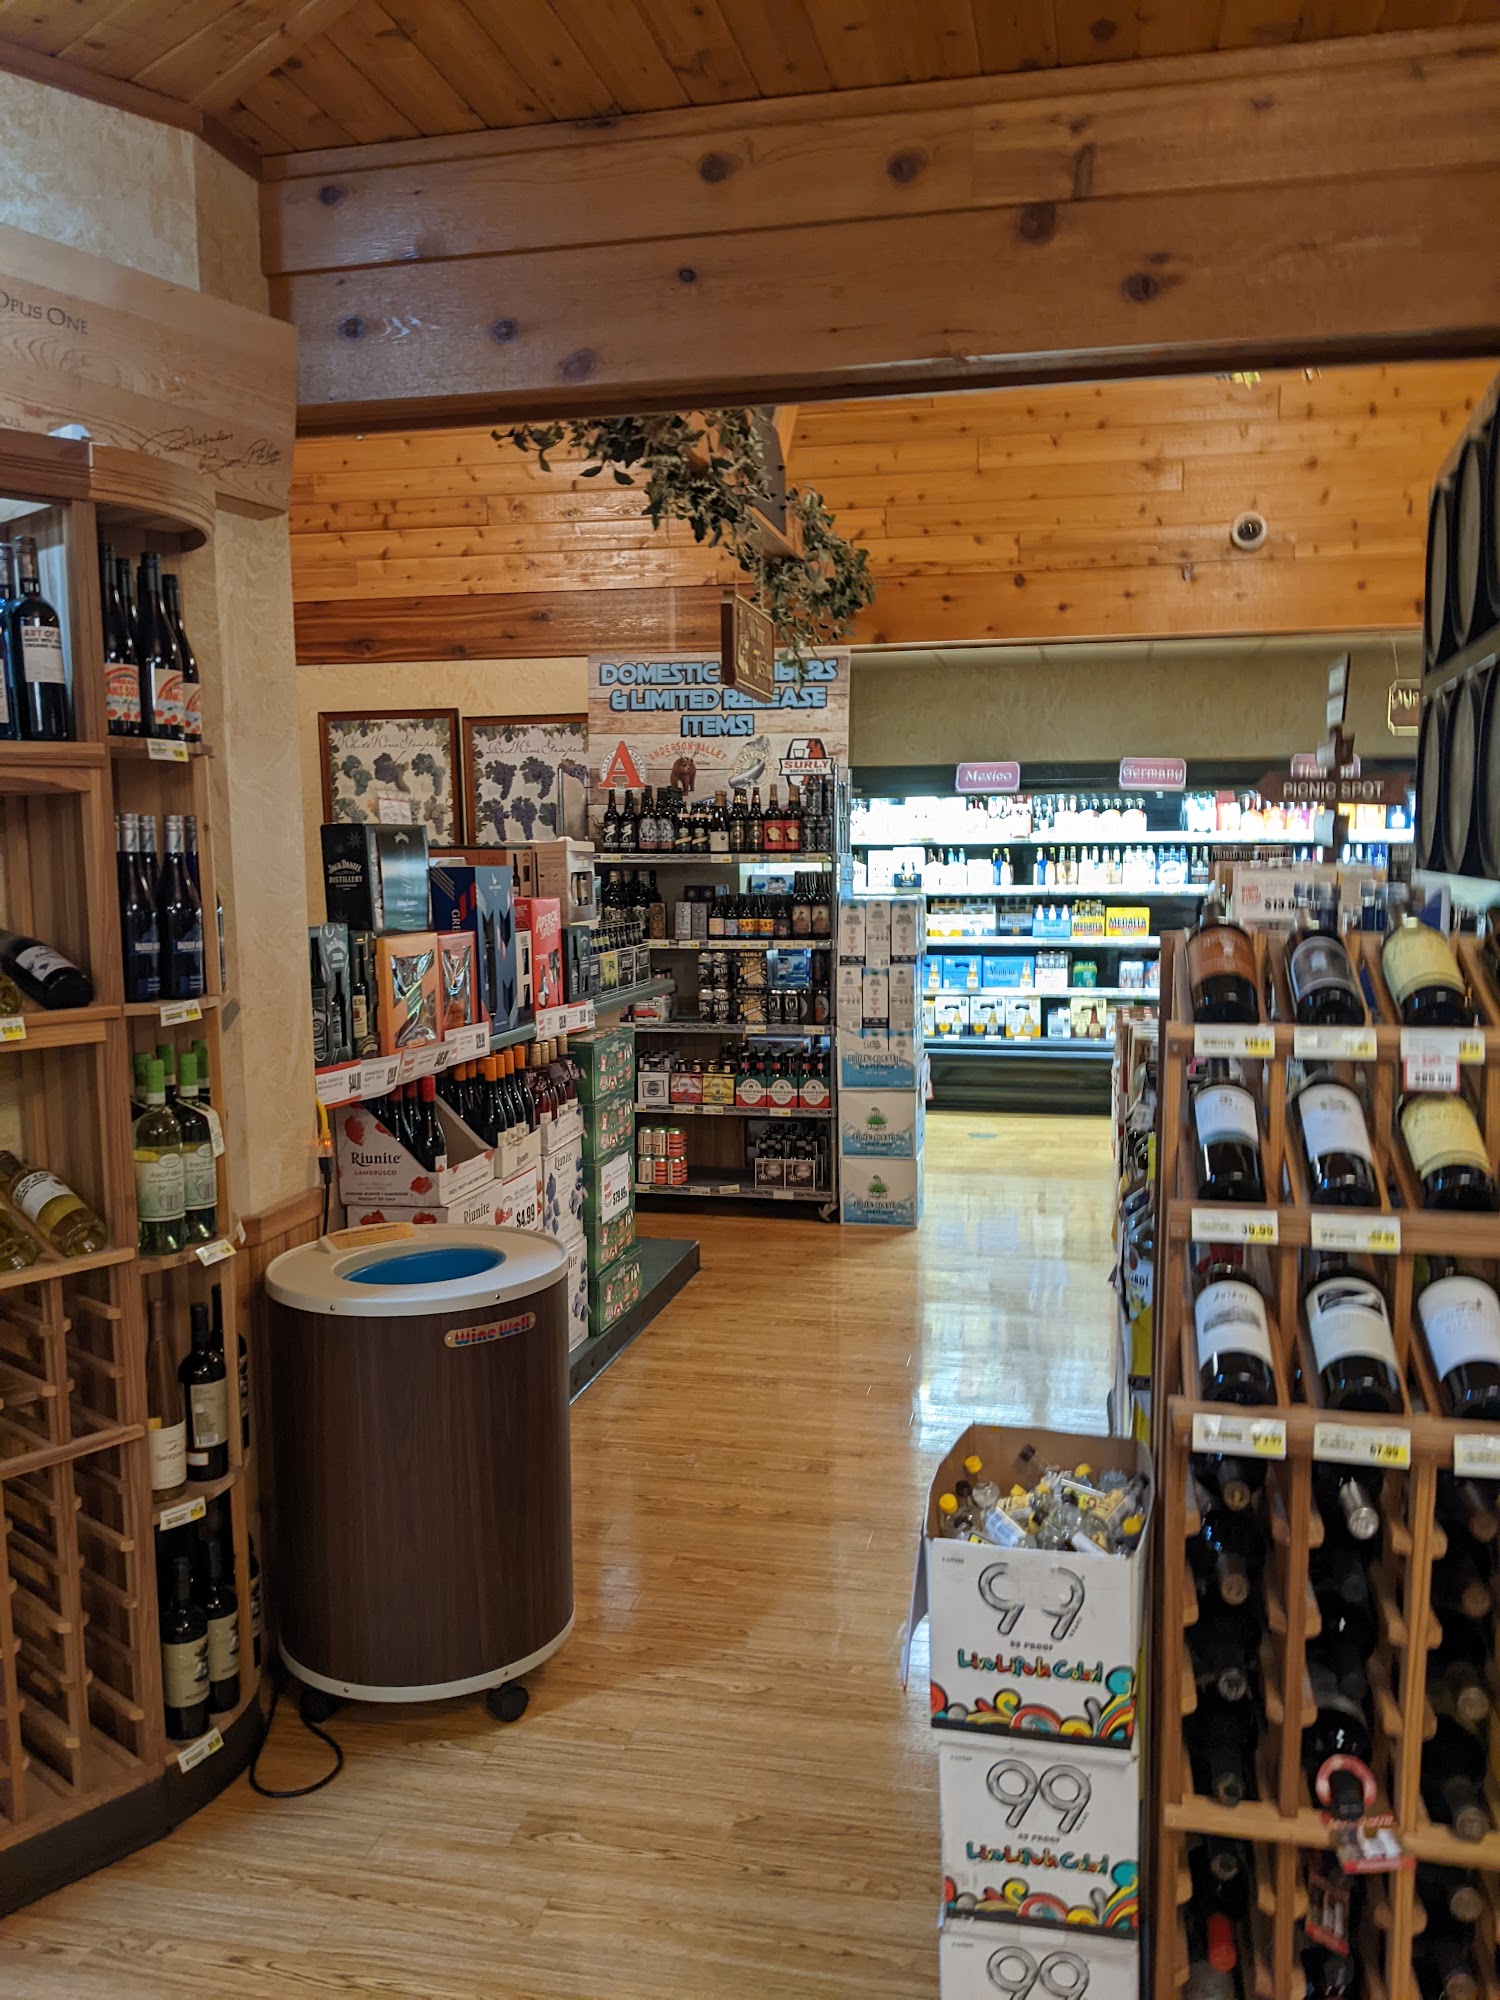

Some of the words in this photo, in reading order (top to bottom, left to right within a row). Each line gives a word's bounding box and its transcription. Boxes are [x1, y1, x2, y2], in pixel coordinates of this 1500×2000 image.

[599, 661, 720, 686] DOMESTIC
[609, 689, 629, 712] &
[629, 688, 720, 711] LIMITED
[681, 714, 754, 738] ITEMS!
[648, 741, 694, 761] ANDERSON
[695, 742, 728, 761] VALLEY
[784, 760, 829, 769] SURLY
[1122, 765, 1183, 780] Germany
[964, 770, 1013, 782] Mexico
[1283, 781, 1337, 800] PICNIC
[1341, 781, 1385, 800] SPOT
[1073, 922, 1103, 932] MEDALLA
[1108, 917, 1147, 929] MEDALLA
[351, 1152, 401, 1168] Riunite
[463, 1202, 491, 1224] Riunite
[516, 1203, 535, 1228] $4.99
[455, 1328, 497, 1346] Wine
[499, 1314, 530, 1337] Well
[1023, 1642, 1054, 1651] PROOF
[986, 1758, 1092, 1834] 99
